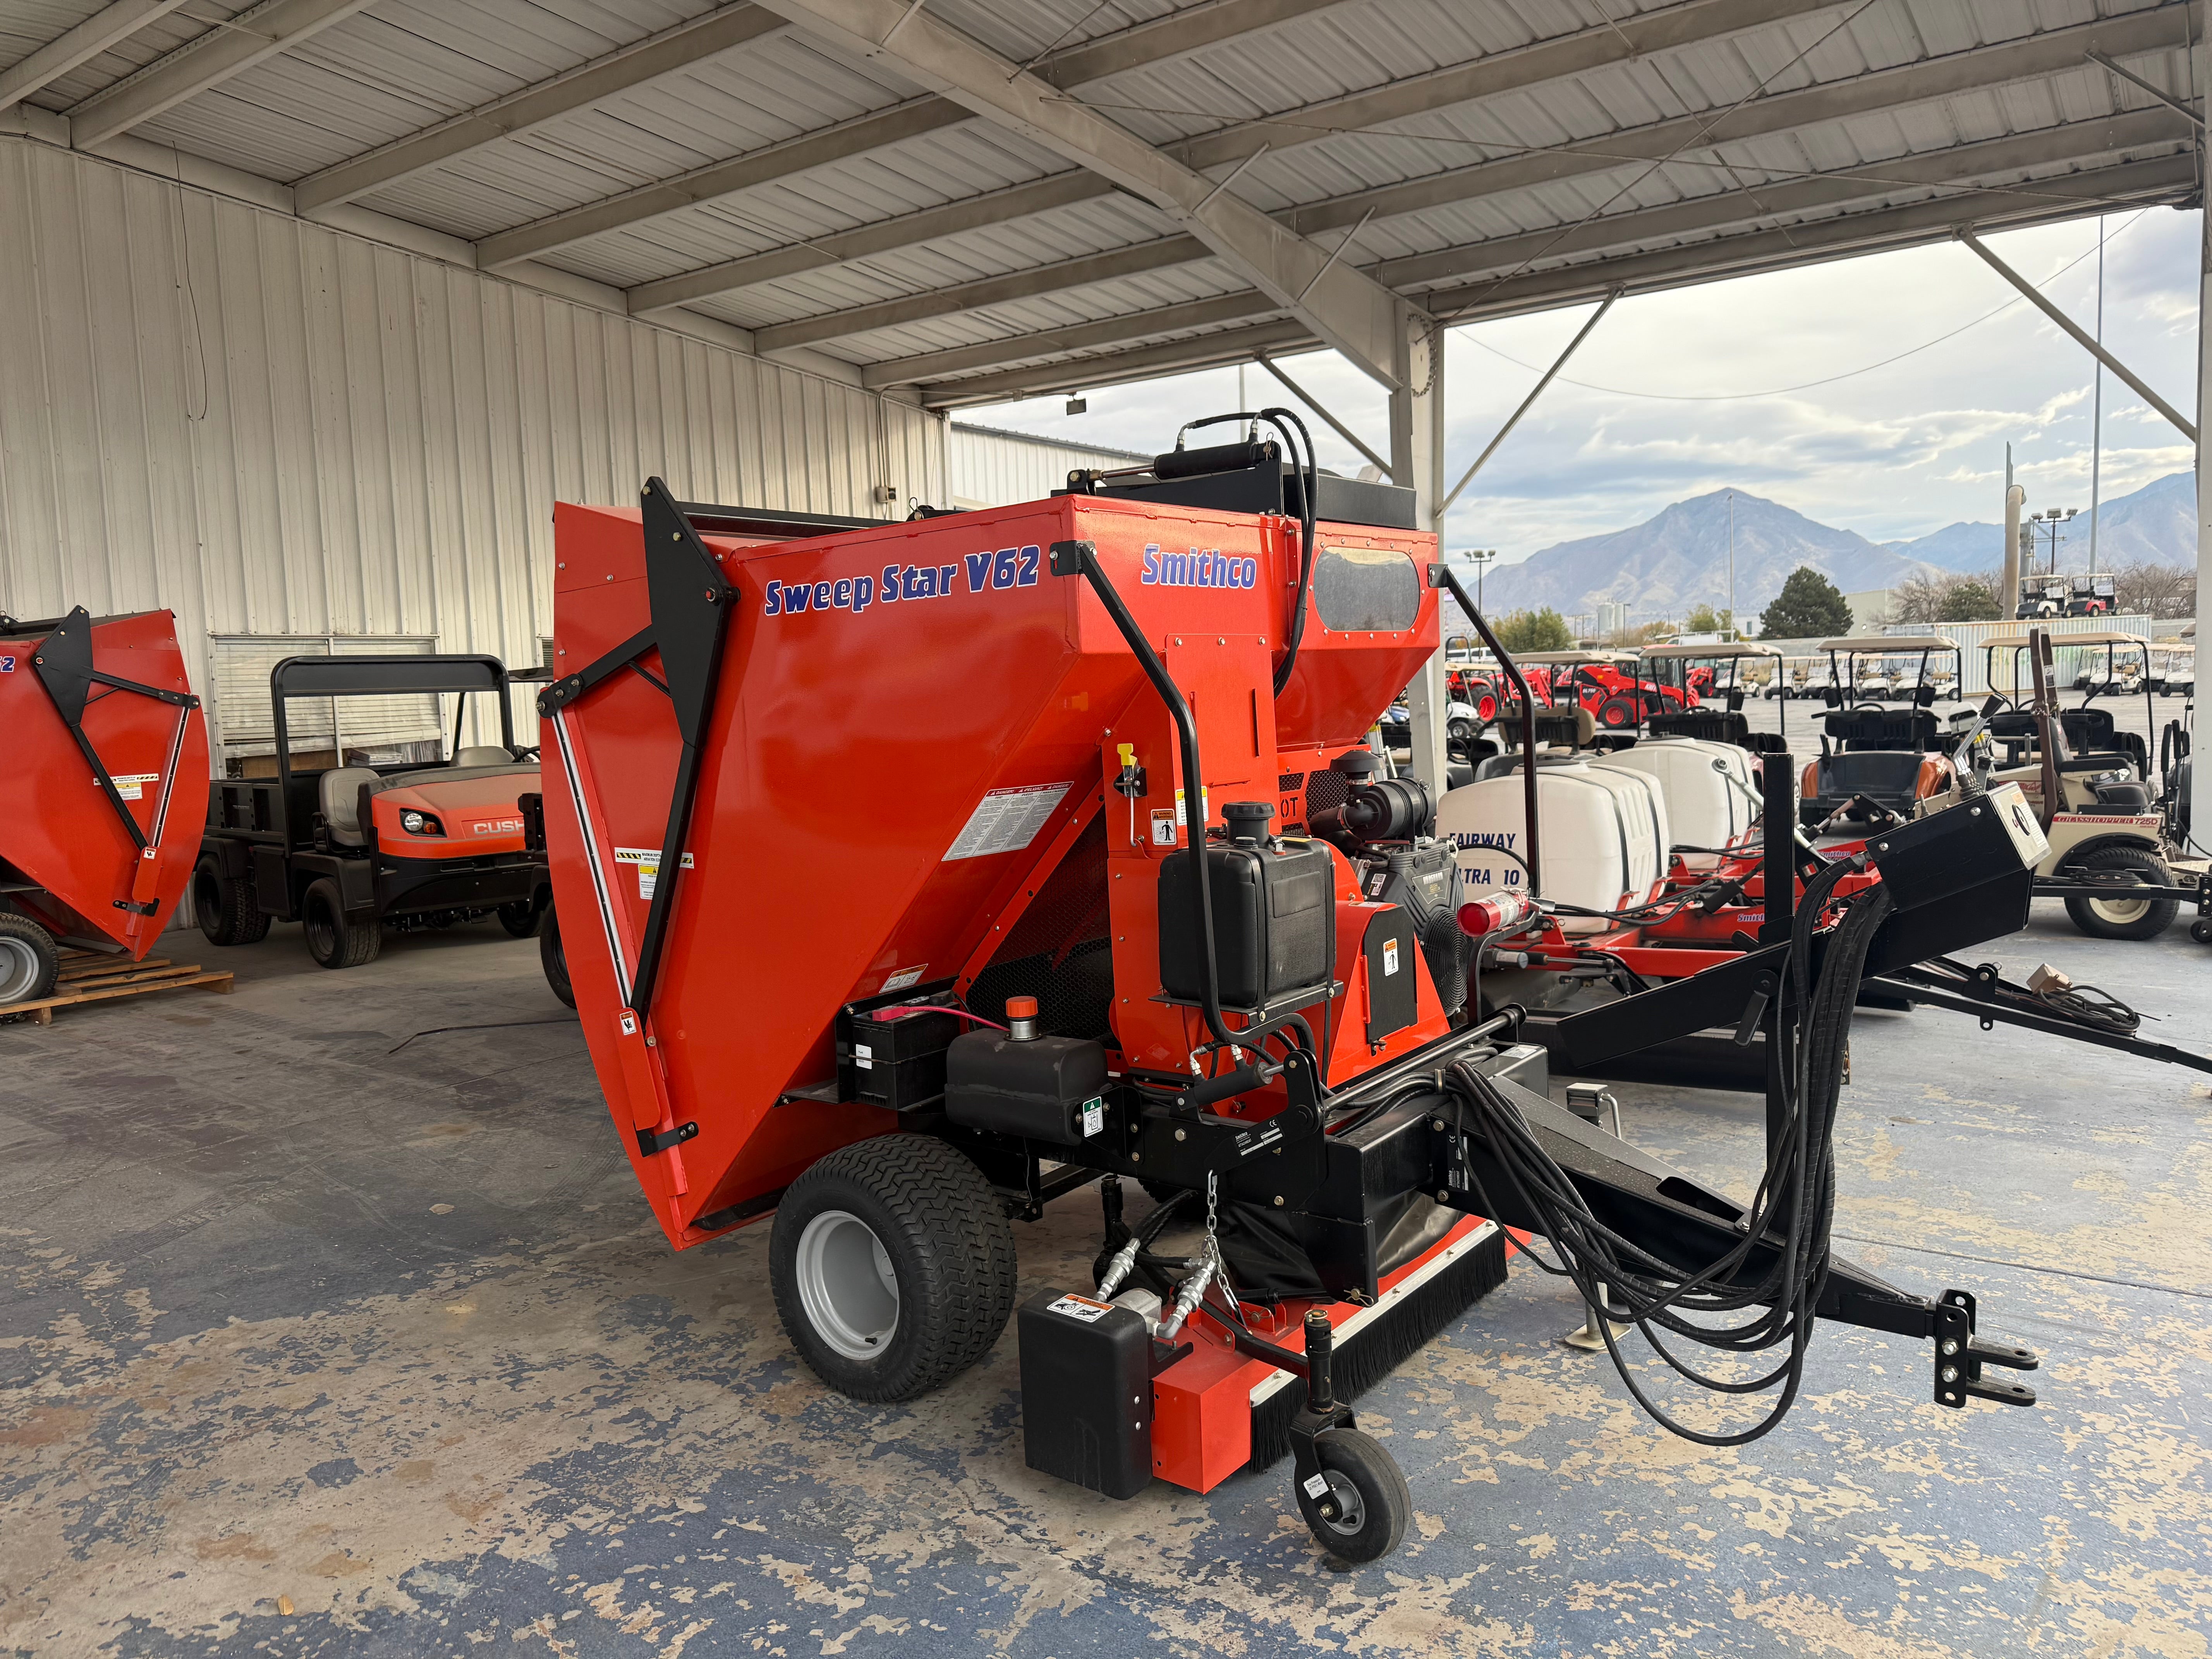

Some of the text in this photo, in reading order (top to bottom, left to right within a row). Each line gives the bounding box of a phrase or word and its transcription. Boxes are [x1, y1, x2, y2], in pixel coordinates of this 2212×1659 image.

[765, 544, 1040, 616] Sweep Star V62
[1141, 543, 1257, 589] Smithco
[1504, 869, 1520, 885] 10
